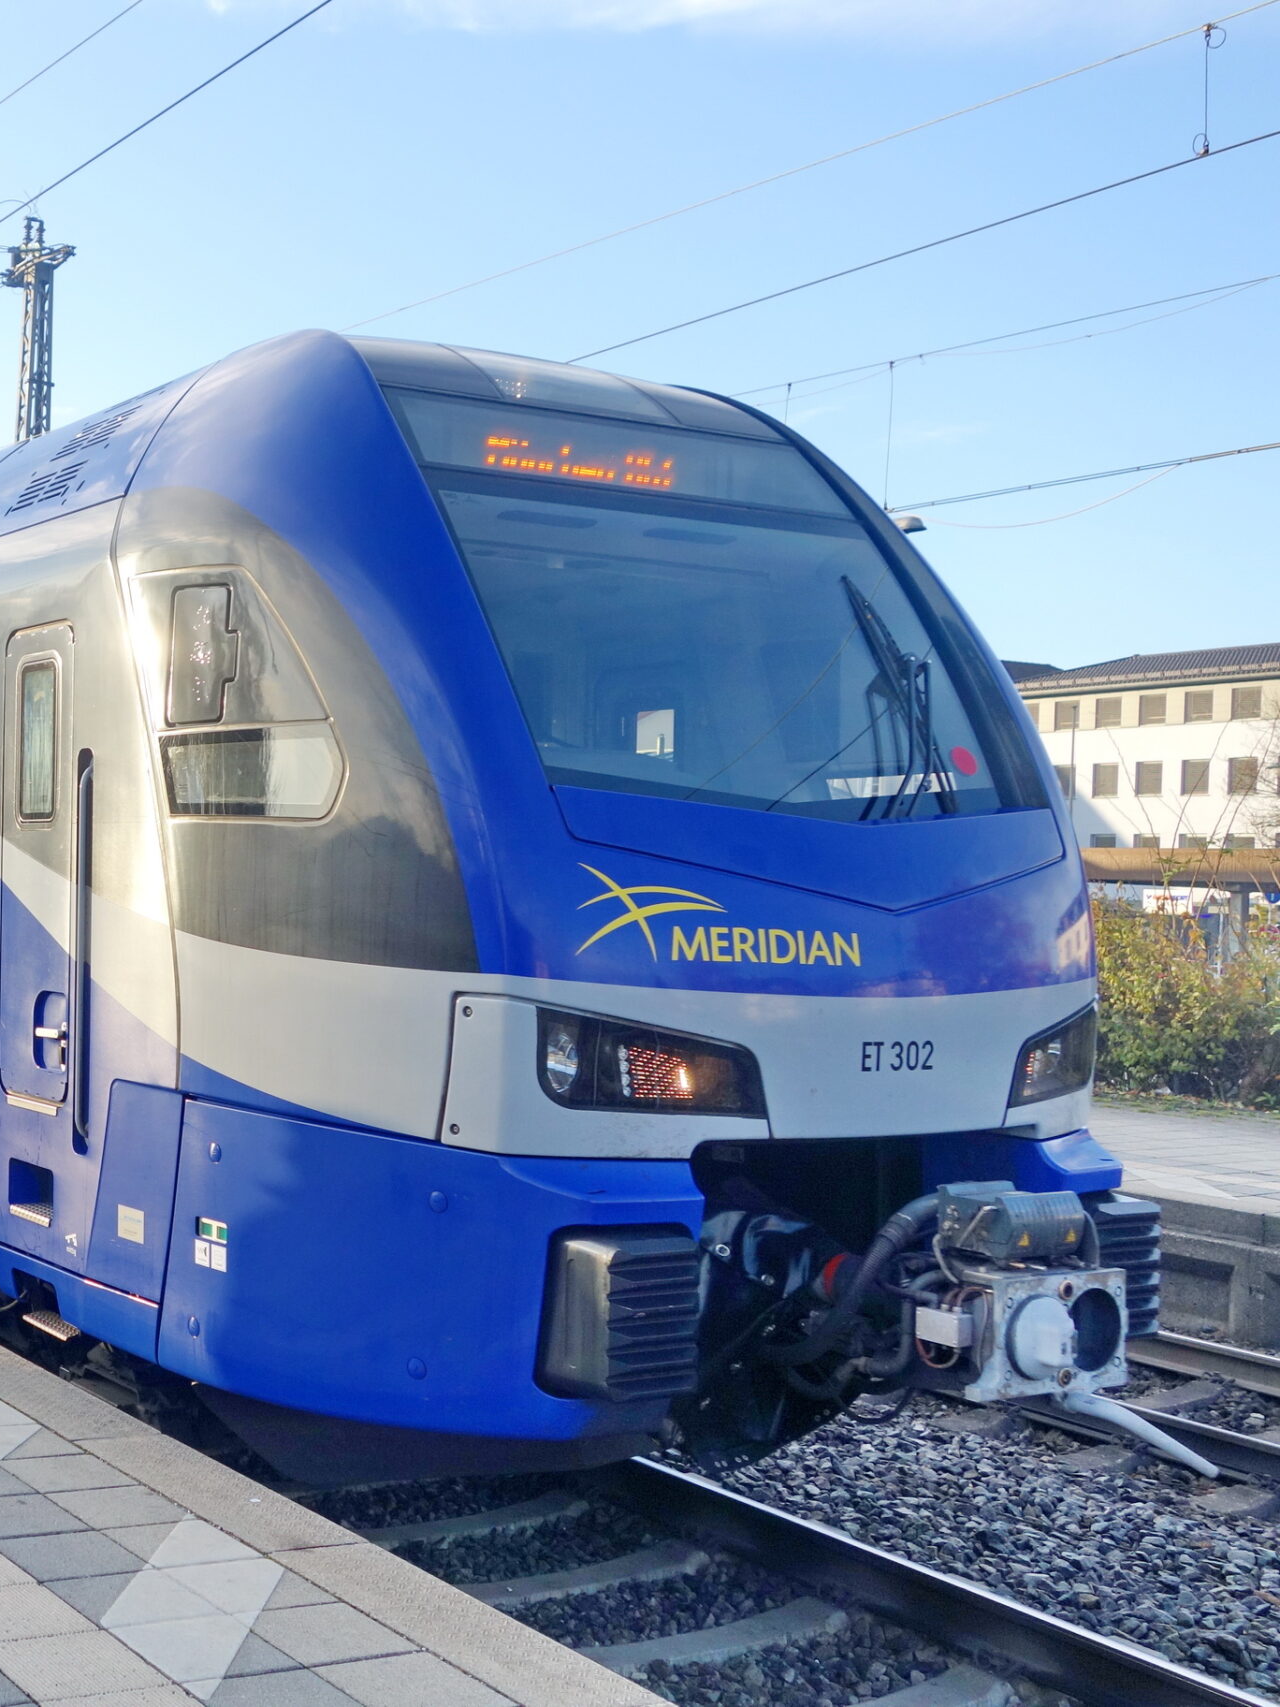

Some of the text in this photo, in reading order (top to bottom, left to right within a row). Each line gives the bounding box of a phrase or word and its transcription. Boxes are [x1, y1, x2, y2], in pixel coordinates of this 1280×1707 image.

[671, 926, 861, 967] MERIDIAN
[861, 1040, 934, 1072] ET 302
